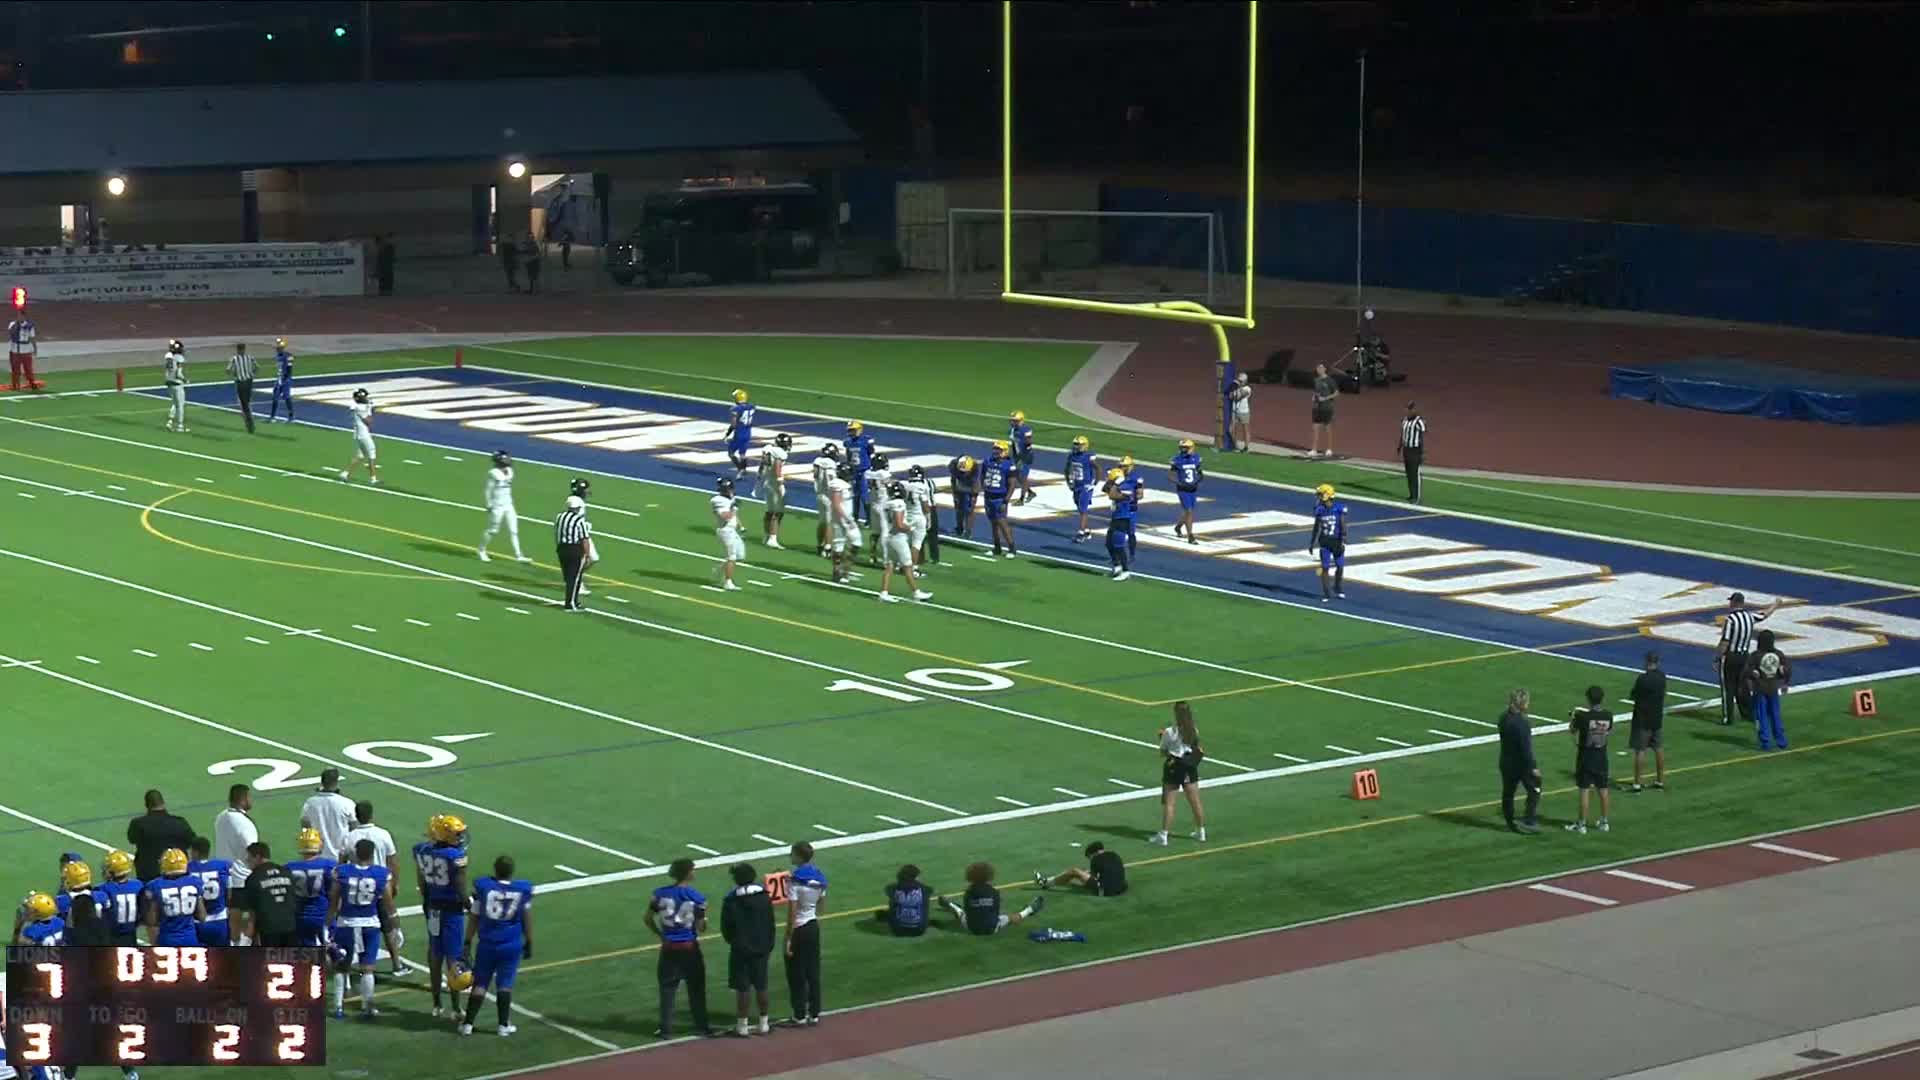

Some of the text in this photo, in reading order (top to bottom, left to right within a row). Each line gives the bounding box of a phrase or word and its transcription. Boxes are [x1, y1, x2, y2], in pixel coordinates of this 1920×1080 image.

[1184, 468, 1195, 483] 3
[823, 667, 1016, 702] 10
[1860, 692, 1872, 712] G
[207, 740, 458, 791] 20
[1359, 773, 1378, 796] 10
[191, 870, 220, 900] 5
[116, 893, 137, 924] 11
[161, 885, 198, 917] 56
[485, 889, 523, 920] 67
